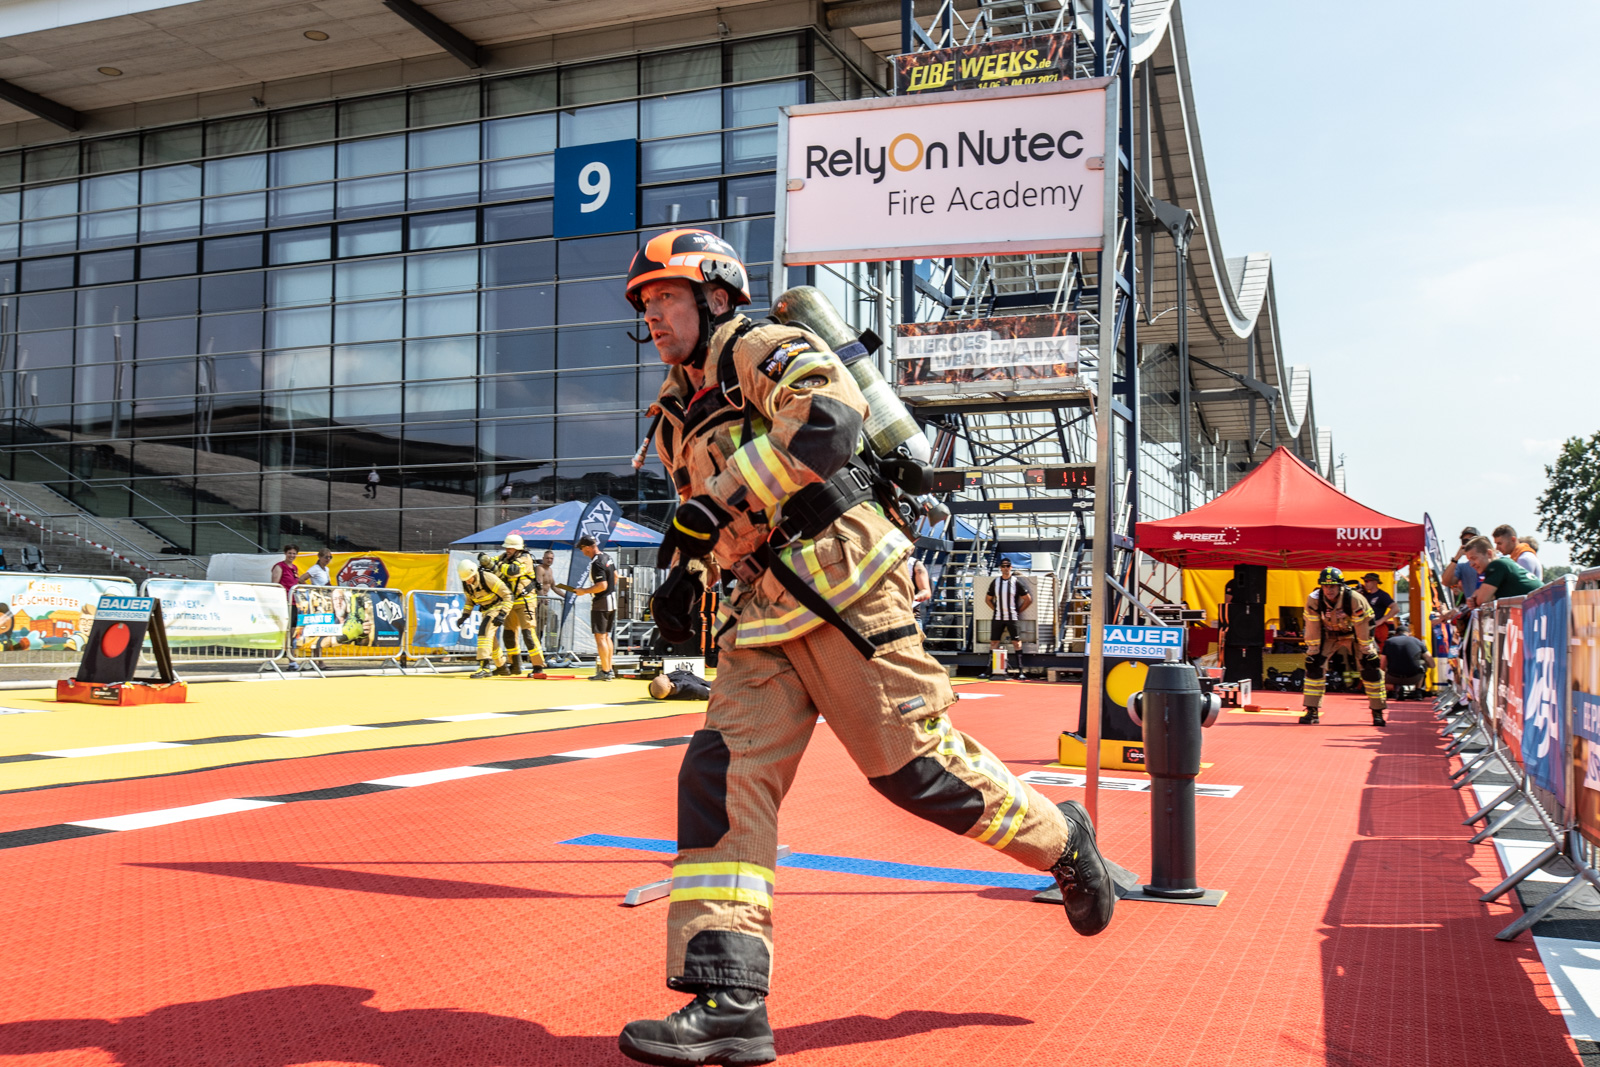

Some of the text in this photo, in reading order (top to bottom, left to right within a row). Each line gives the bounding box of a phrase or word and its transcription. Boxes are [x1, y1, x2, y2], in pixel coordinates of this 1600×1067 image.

[907, 60, 956, 91] FIRE
[806, 127, 1084, 185] RelyOn Nutec
[578, 161, 611, 214] 9
[888, 181, 1084, 216] Fire Academy
[908, 334, 987, 355] HEROES
[935, 340, 1067, 368] WEAR HAIX
[535, 528, 565, 536] Bull
[1336, 527, 1382, 540] RUKU
[28, 580, 62, 593] KLEINE
[11, 594, 79, 608] LÖSCHMEISTER
[99, 598, 151, 610] BAUER
[97, 611, 148, 619] KOMPRESSOREN
[1103, 645, 1167, 656] MPRESSOR
